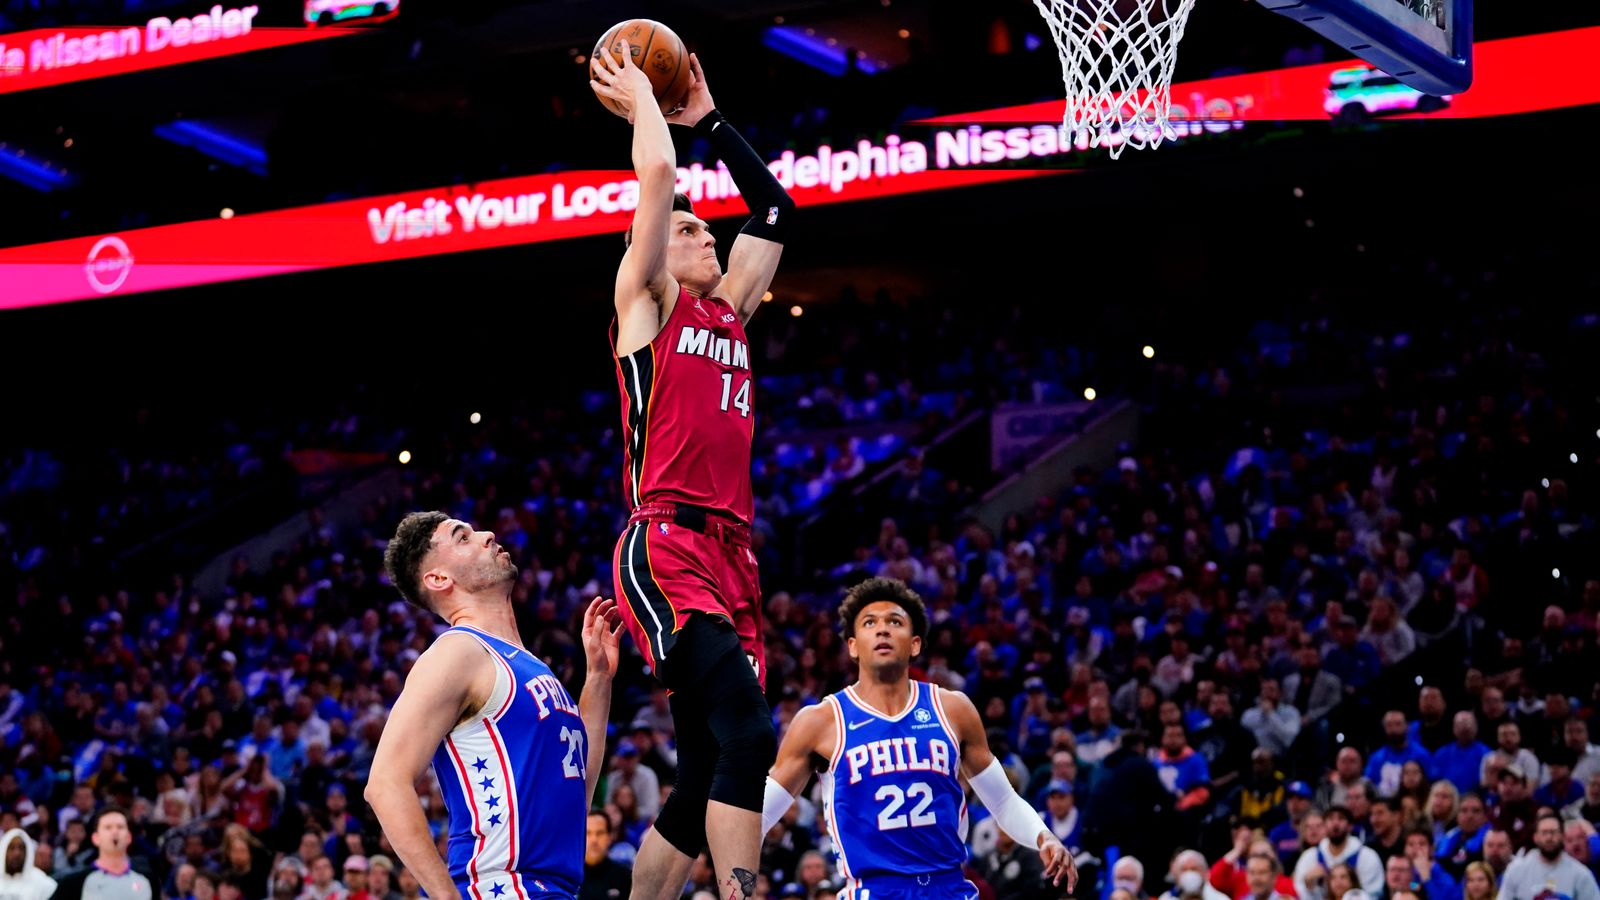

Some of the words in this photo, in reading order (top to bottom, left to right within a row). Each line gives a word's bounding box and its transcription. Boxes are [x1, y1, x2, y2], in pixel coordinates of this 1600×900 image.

[29, 31, 140, 73] Nissan
[145, 5, 259, 52] Dealer
[367, 197, 453, 244] Visit
[454, 193, 546, 232] Your
[552, 180, 641, 221] Loca
[675, 134, 929, 202] Phidelphia
[935, 124, 1090, 169] Nissan
[720, 372, 751, 418] 14
[845, 736, 951, 785] PHILA
[874, 781, 937, 832] 22
